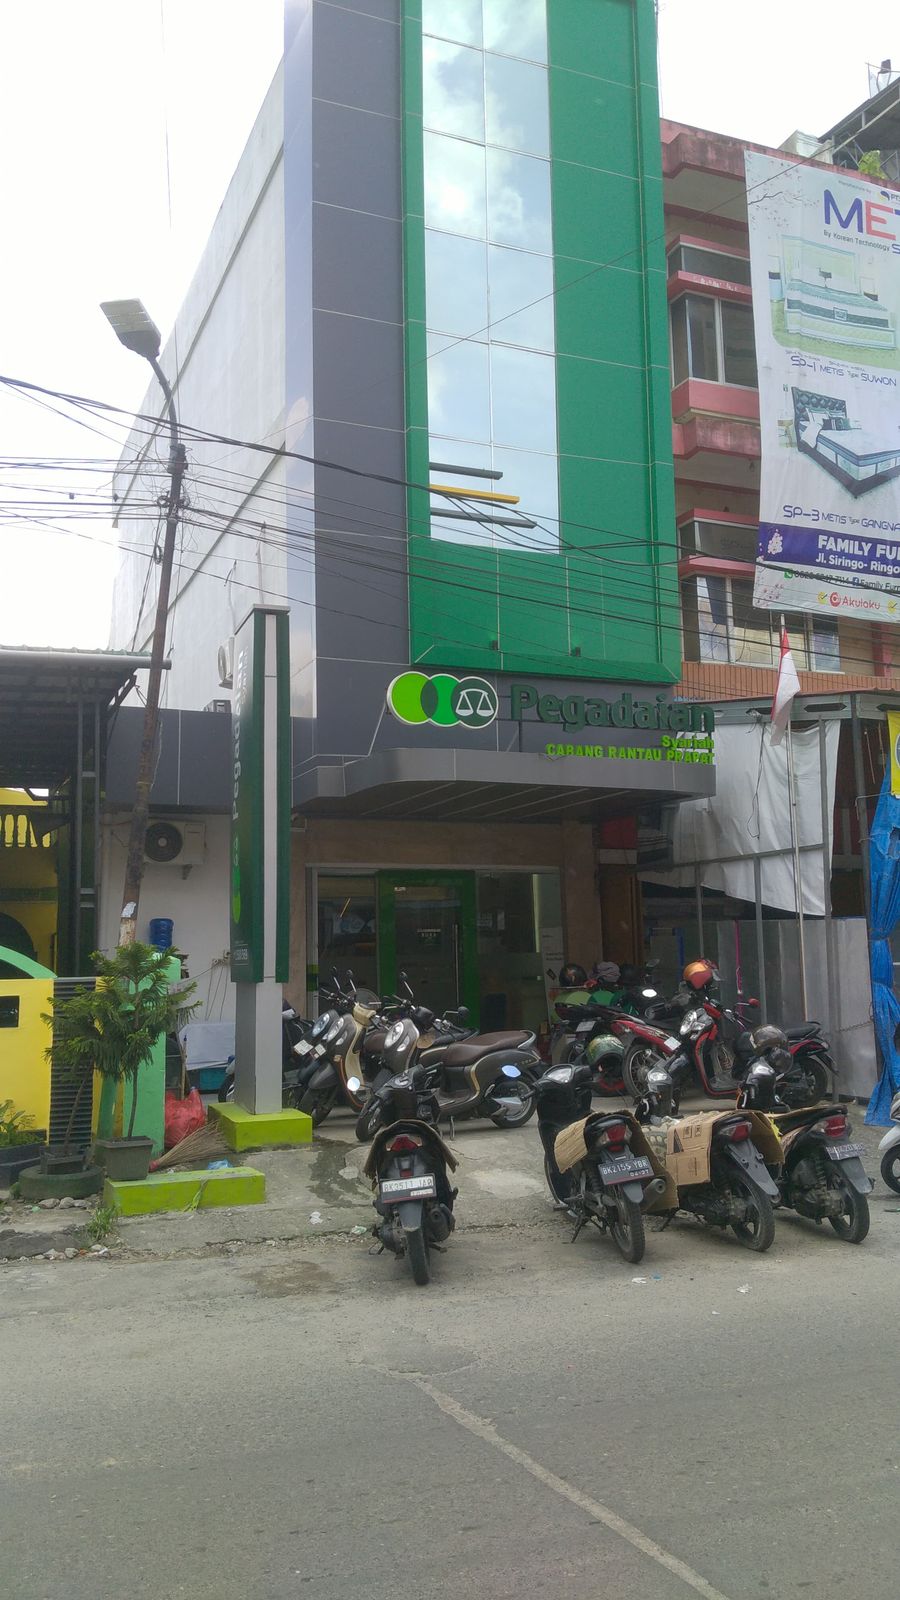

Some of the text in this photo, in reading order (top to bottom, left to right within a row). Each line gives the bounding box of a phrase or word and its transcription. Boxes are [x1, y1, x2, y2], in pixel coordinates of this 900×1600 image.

[833, 232, 854, 243] Korean
[855, 237, 890, 251] Technology
[820, 364, 845, 376] METIS
[861, 372, 897, 387] SUWON
[783, 504, 820, 522] SP-3
[822, 512, 847, 525] METIS
[816, 552, 827, 564] Jl.
[818, 534, 900, 562] FAMILY FU
[842, 595, 880, 610] Akulaku
[511, 683, 715, 733] Pegadaian
[662, 735, 715, 750] Syariah
[546, 743, 715, 765] CABANG RANTAU PRAPAT
